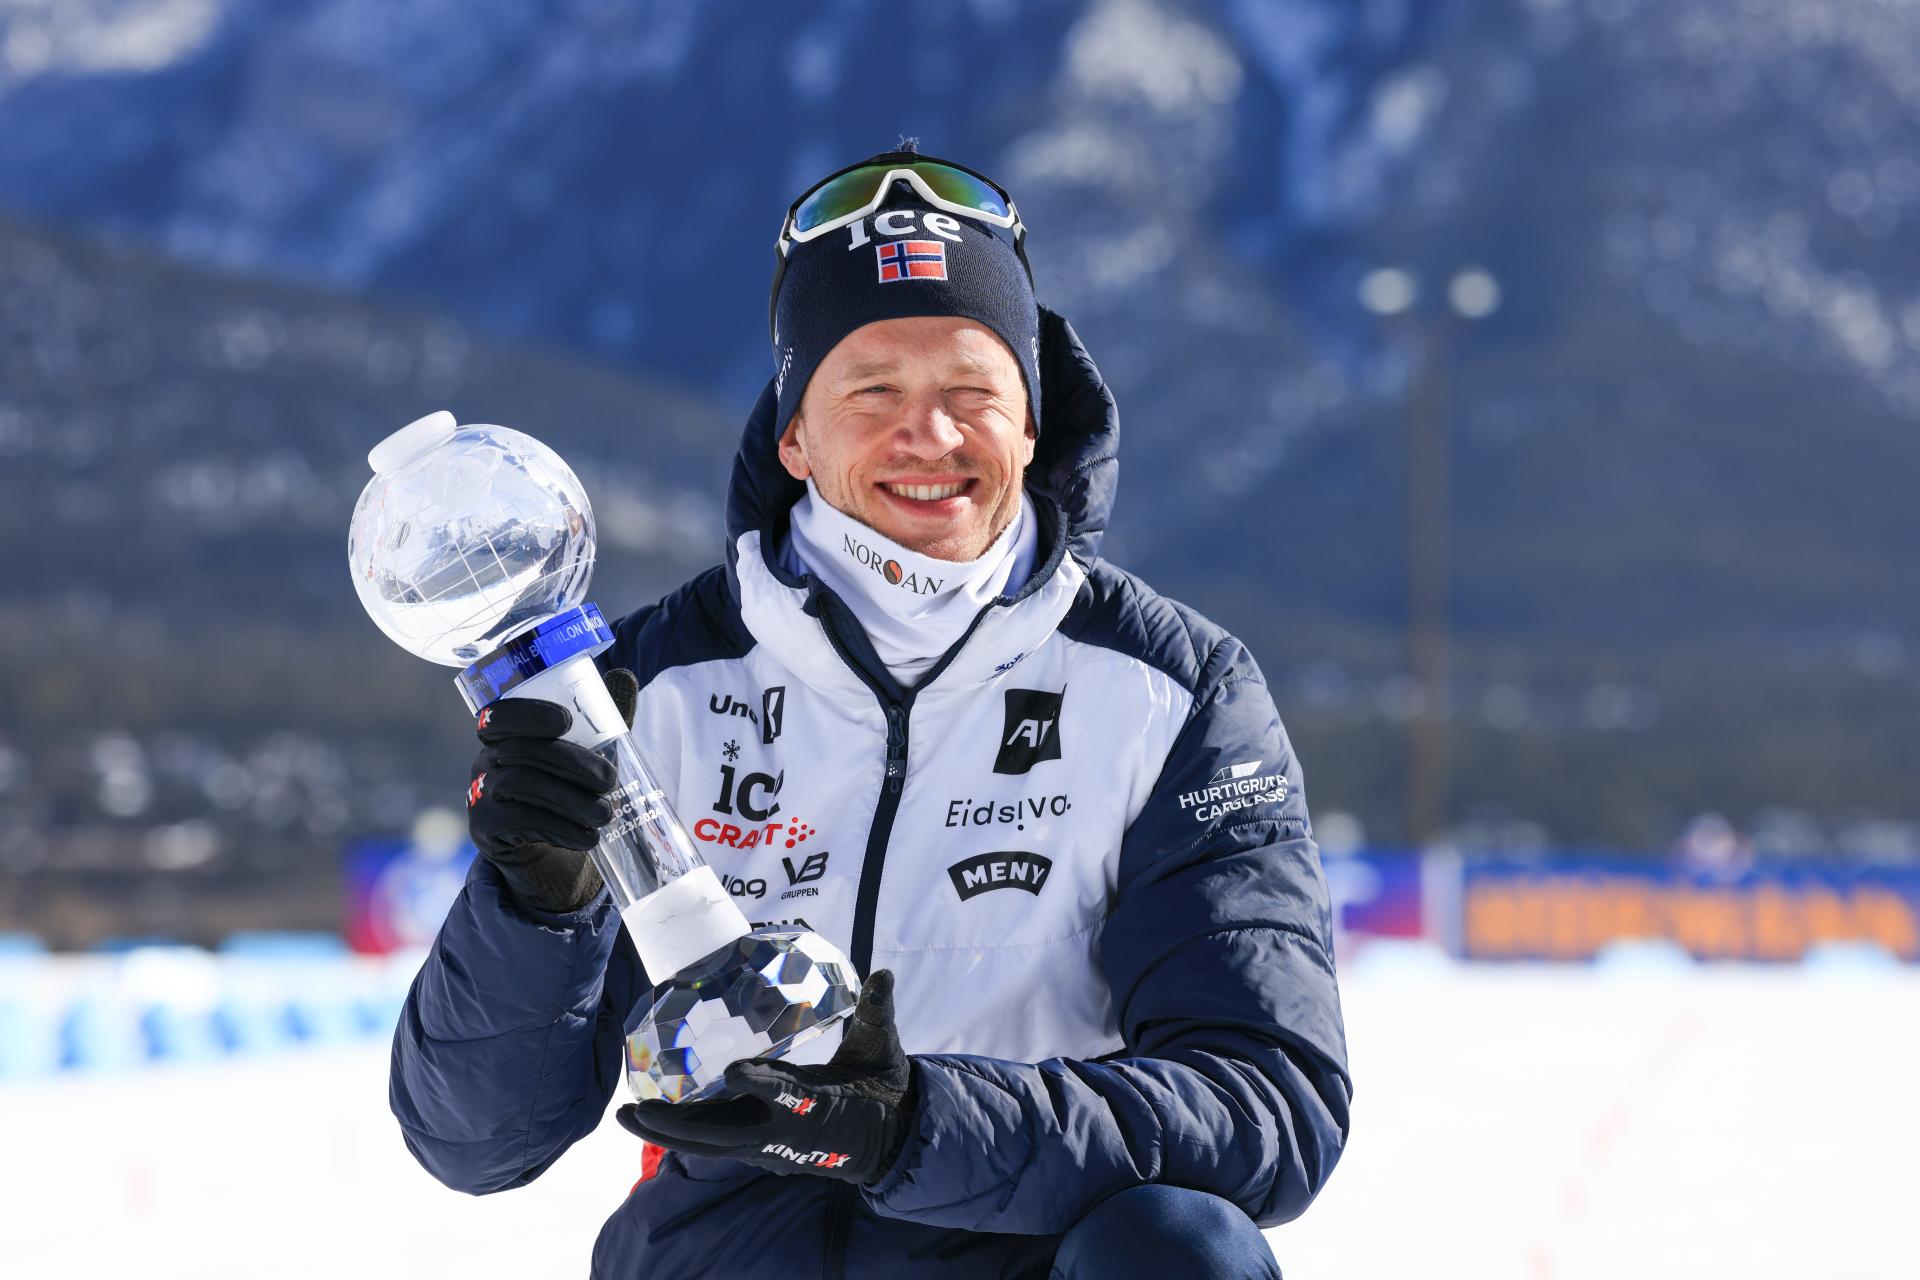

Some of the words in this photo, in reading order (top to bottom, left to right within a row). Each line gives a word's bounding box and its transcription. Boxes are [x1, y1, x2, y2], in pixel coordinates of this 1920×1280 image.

[846, 210, 963, 251] ice
[605, 779, 640, 802] PRINT
[1178, 774, 1289, 809] HURTIGRUTA
[693, 818, 784, 850] CRAT
[781, 851, 829, 886] VB
[961, 860, 1046, 890] MENY
[780, 887, 819, 900] GRUPPEN
